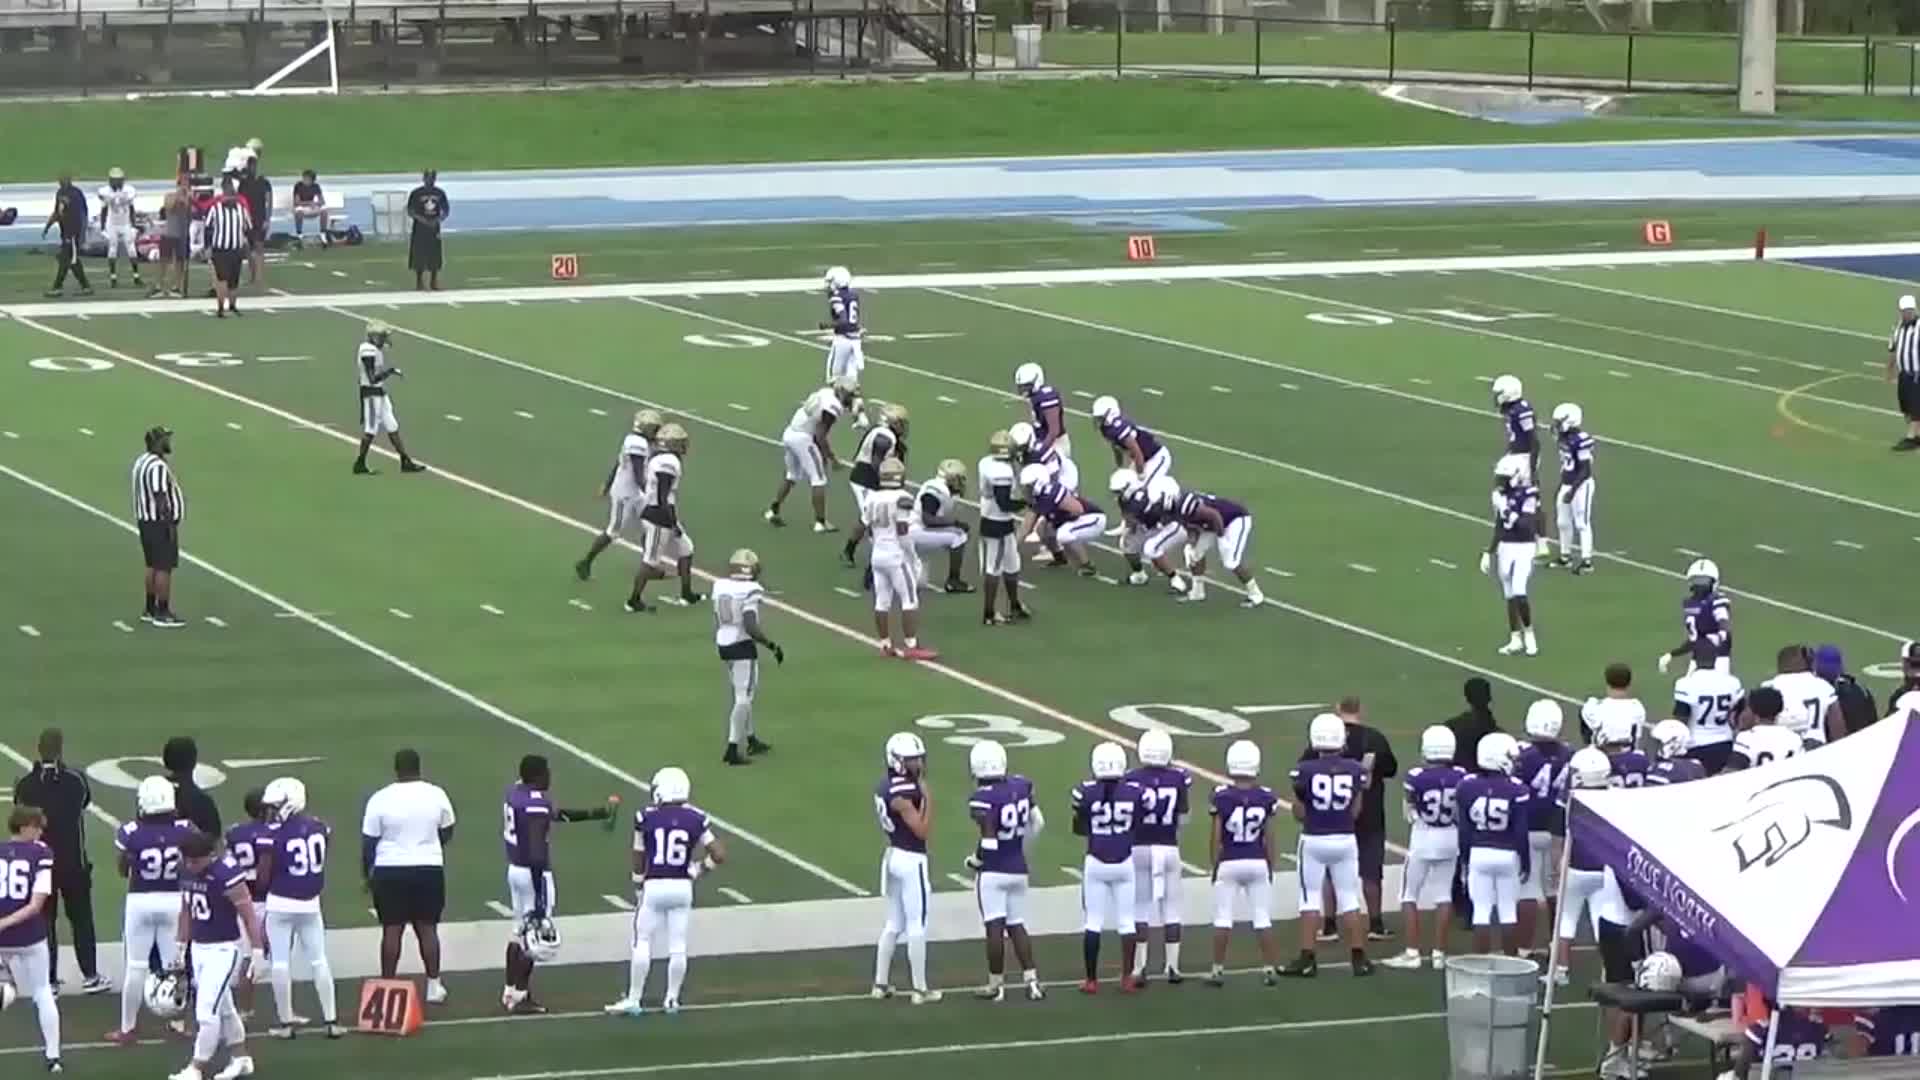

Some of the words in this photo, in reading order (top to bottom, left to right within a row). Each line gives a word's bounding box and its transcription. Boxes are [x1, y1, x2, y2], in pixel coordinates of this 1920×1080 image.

[1133, 239, 1151, 257] 10
[1652, 223, 1667, 241] G
[554, 256, 575, 276] 20
[1698, 694, 1732, 725] 75
[1142, 787, 1178, 825] 27
[1311, 773, 1353, 810] 95
[1091, 801, 1134, 835] 25
[1226, 805, 1266, 842] 42
[1469, 796, 1509, 831] 45
[141, 846, 182, 880] 32
[286, 833, 326, 876] 30
[653, 828, 689, 866] 16
[362, 987, 408, 1029] 40
